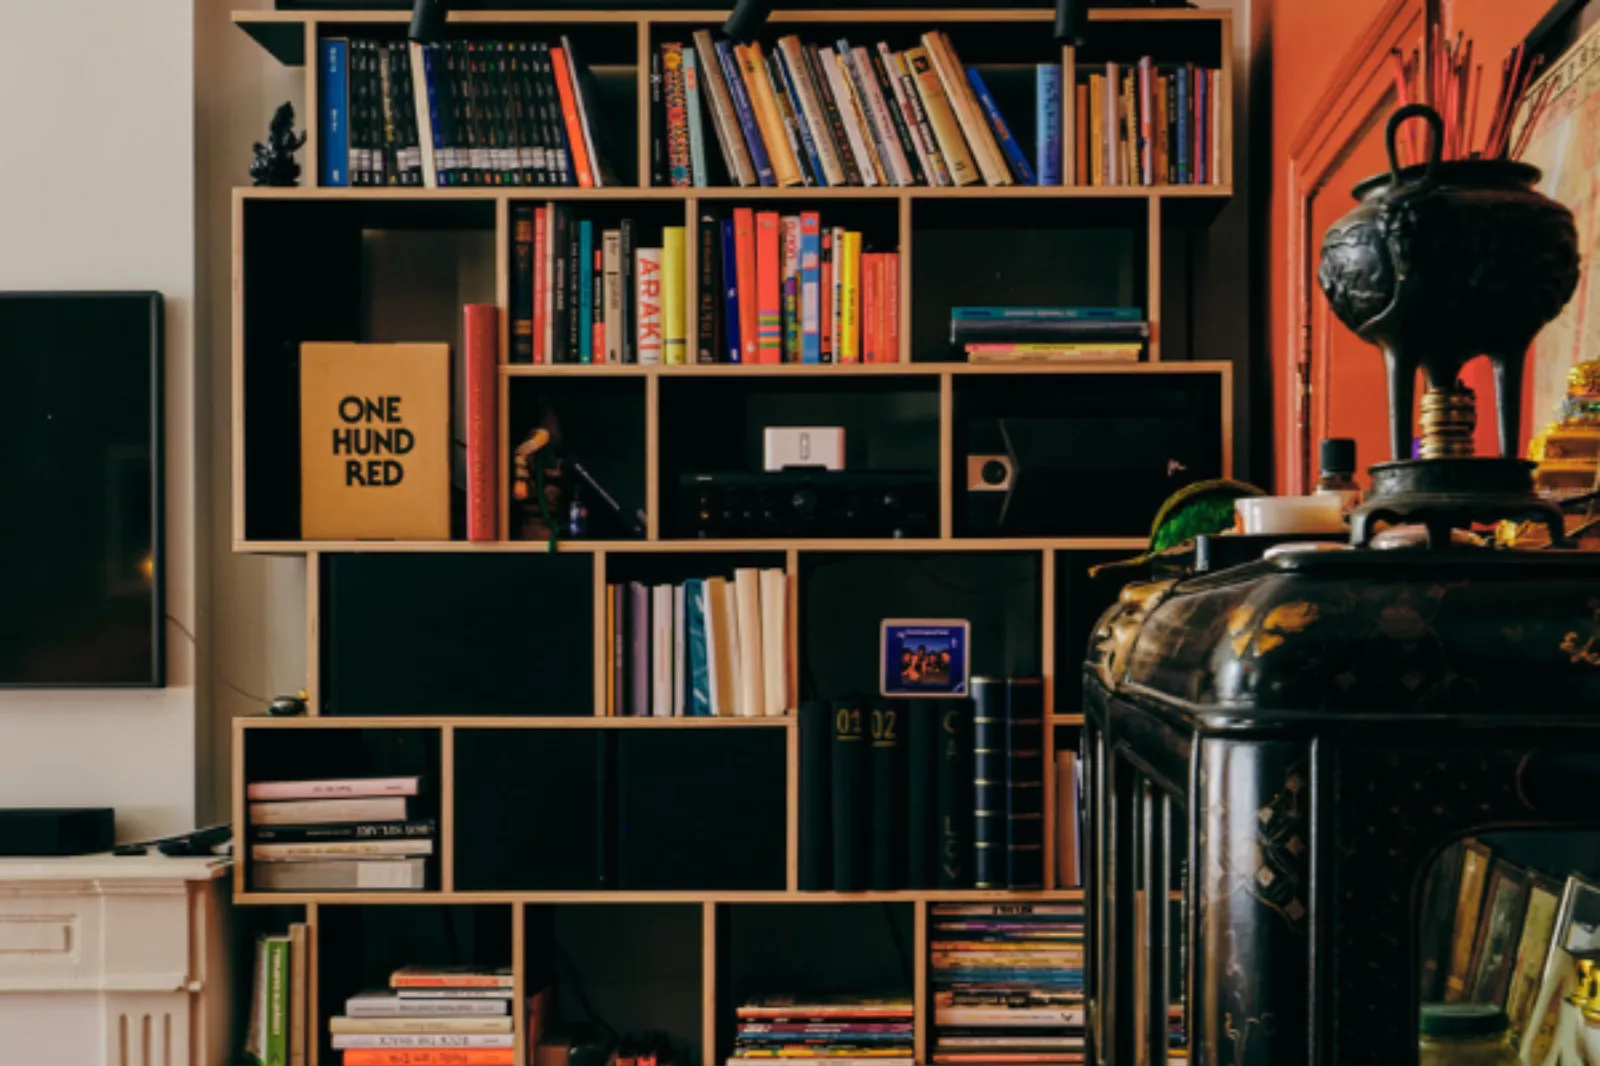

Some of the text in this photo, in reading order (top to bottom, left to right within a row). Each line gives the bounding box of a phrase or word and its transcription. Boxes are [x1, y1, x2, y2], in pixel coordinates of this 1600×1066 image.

[639, 257, 662, 351] ARAKI
[338, 395, 402, 424] ONE
[332, 428, 415, 455] HUND
[345, 460, 404, 487] RED
[836, 707, 862, 734] 01
[871, 709, 898, 740] 02
